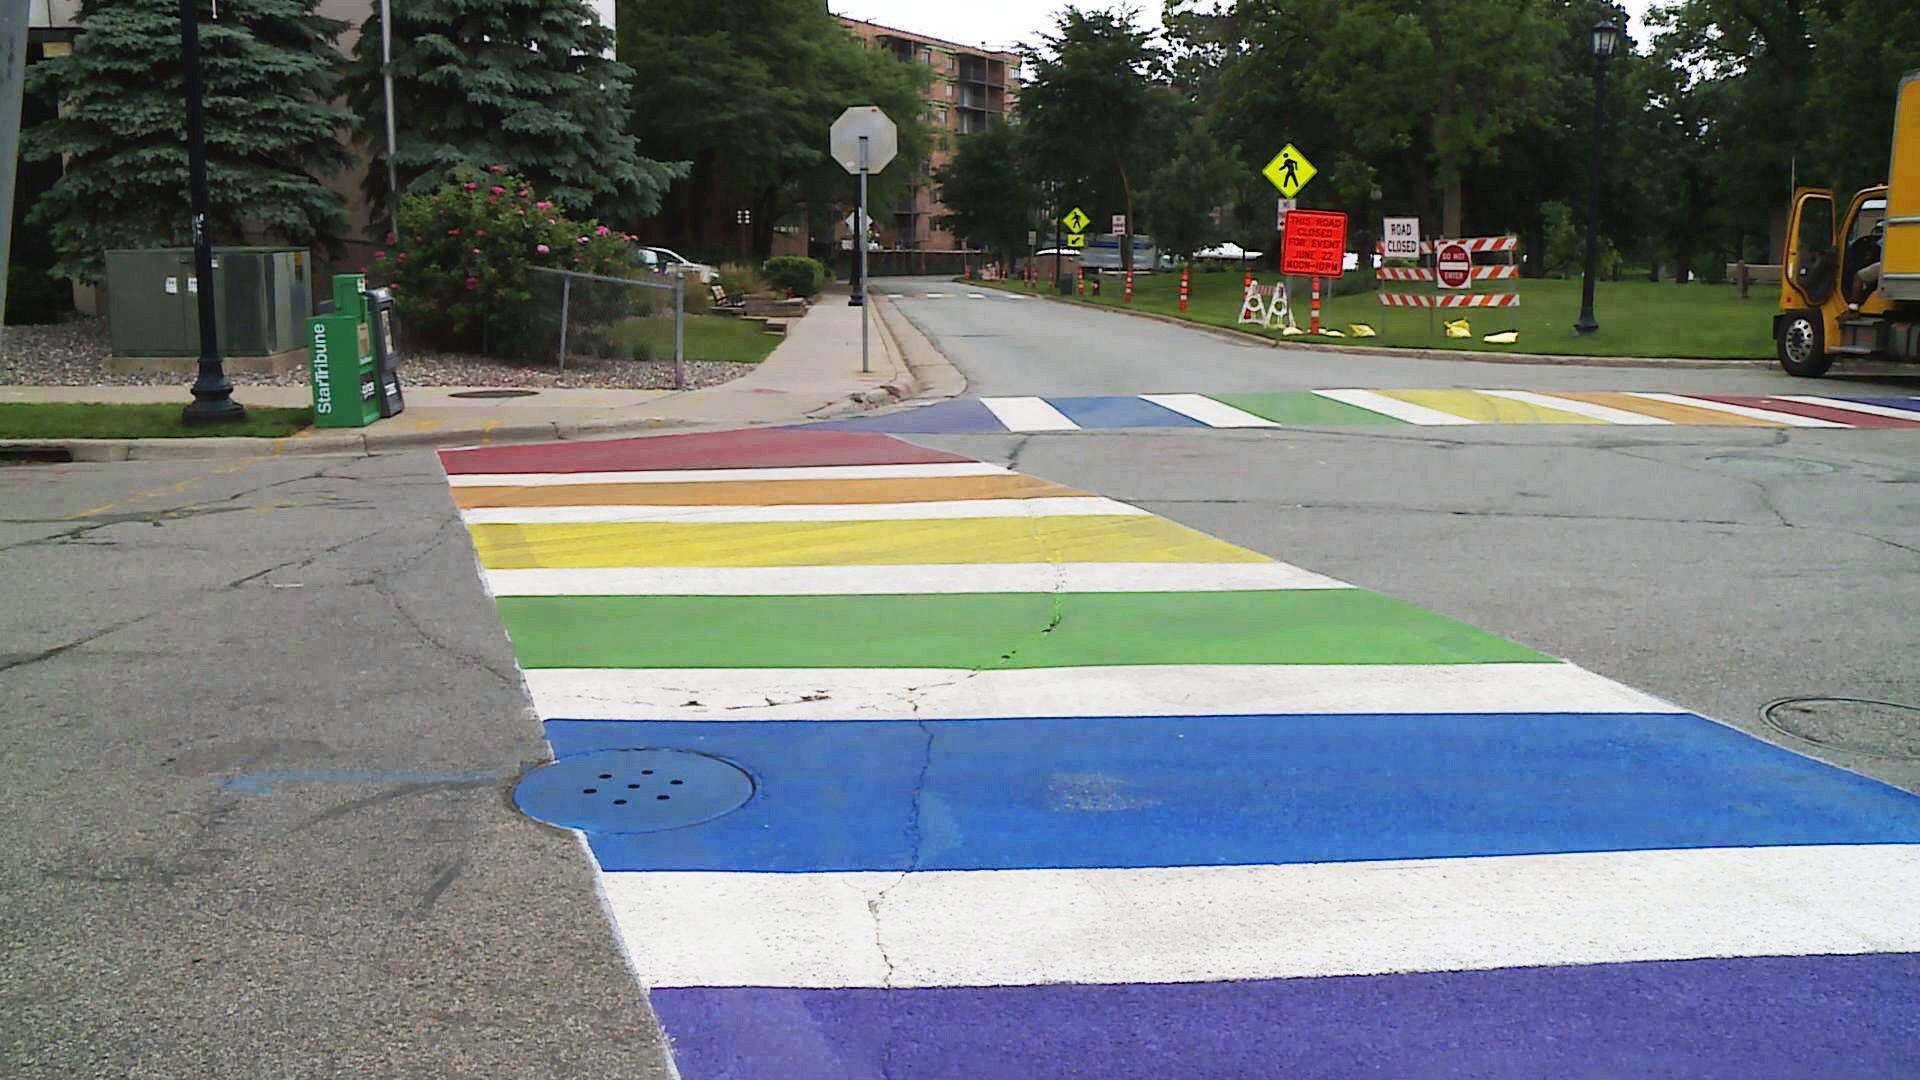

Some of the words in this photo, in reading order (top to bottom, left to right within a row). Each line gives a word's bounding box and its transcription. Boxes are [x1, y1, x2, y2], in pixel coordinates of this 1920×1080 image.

[1290, 216, 1311, 226] THIS
[1316, 218, 1342, 228] ROAD
[1297, 227, 1333, 238] CLOSED
[1391, 223, 1412, 236] ROAD
[1288, 237, 1306, 247] FOR
[1311, 238, 1342, 249] EVENT
[1387, 240, 1417, 253] CLOSED
[1292, 250, 1316, 260] JUNE
[313, 323, 332, 414] StarTribune
